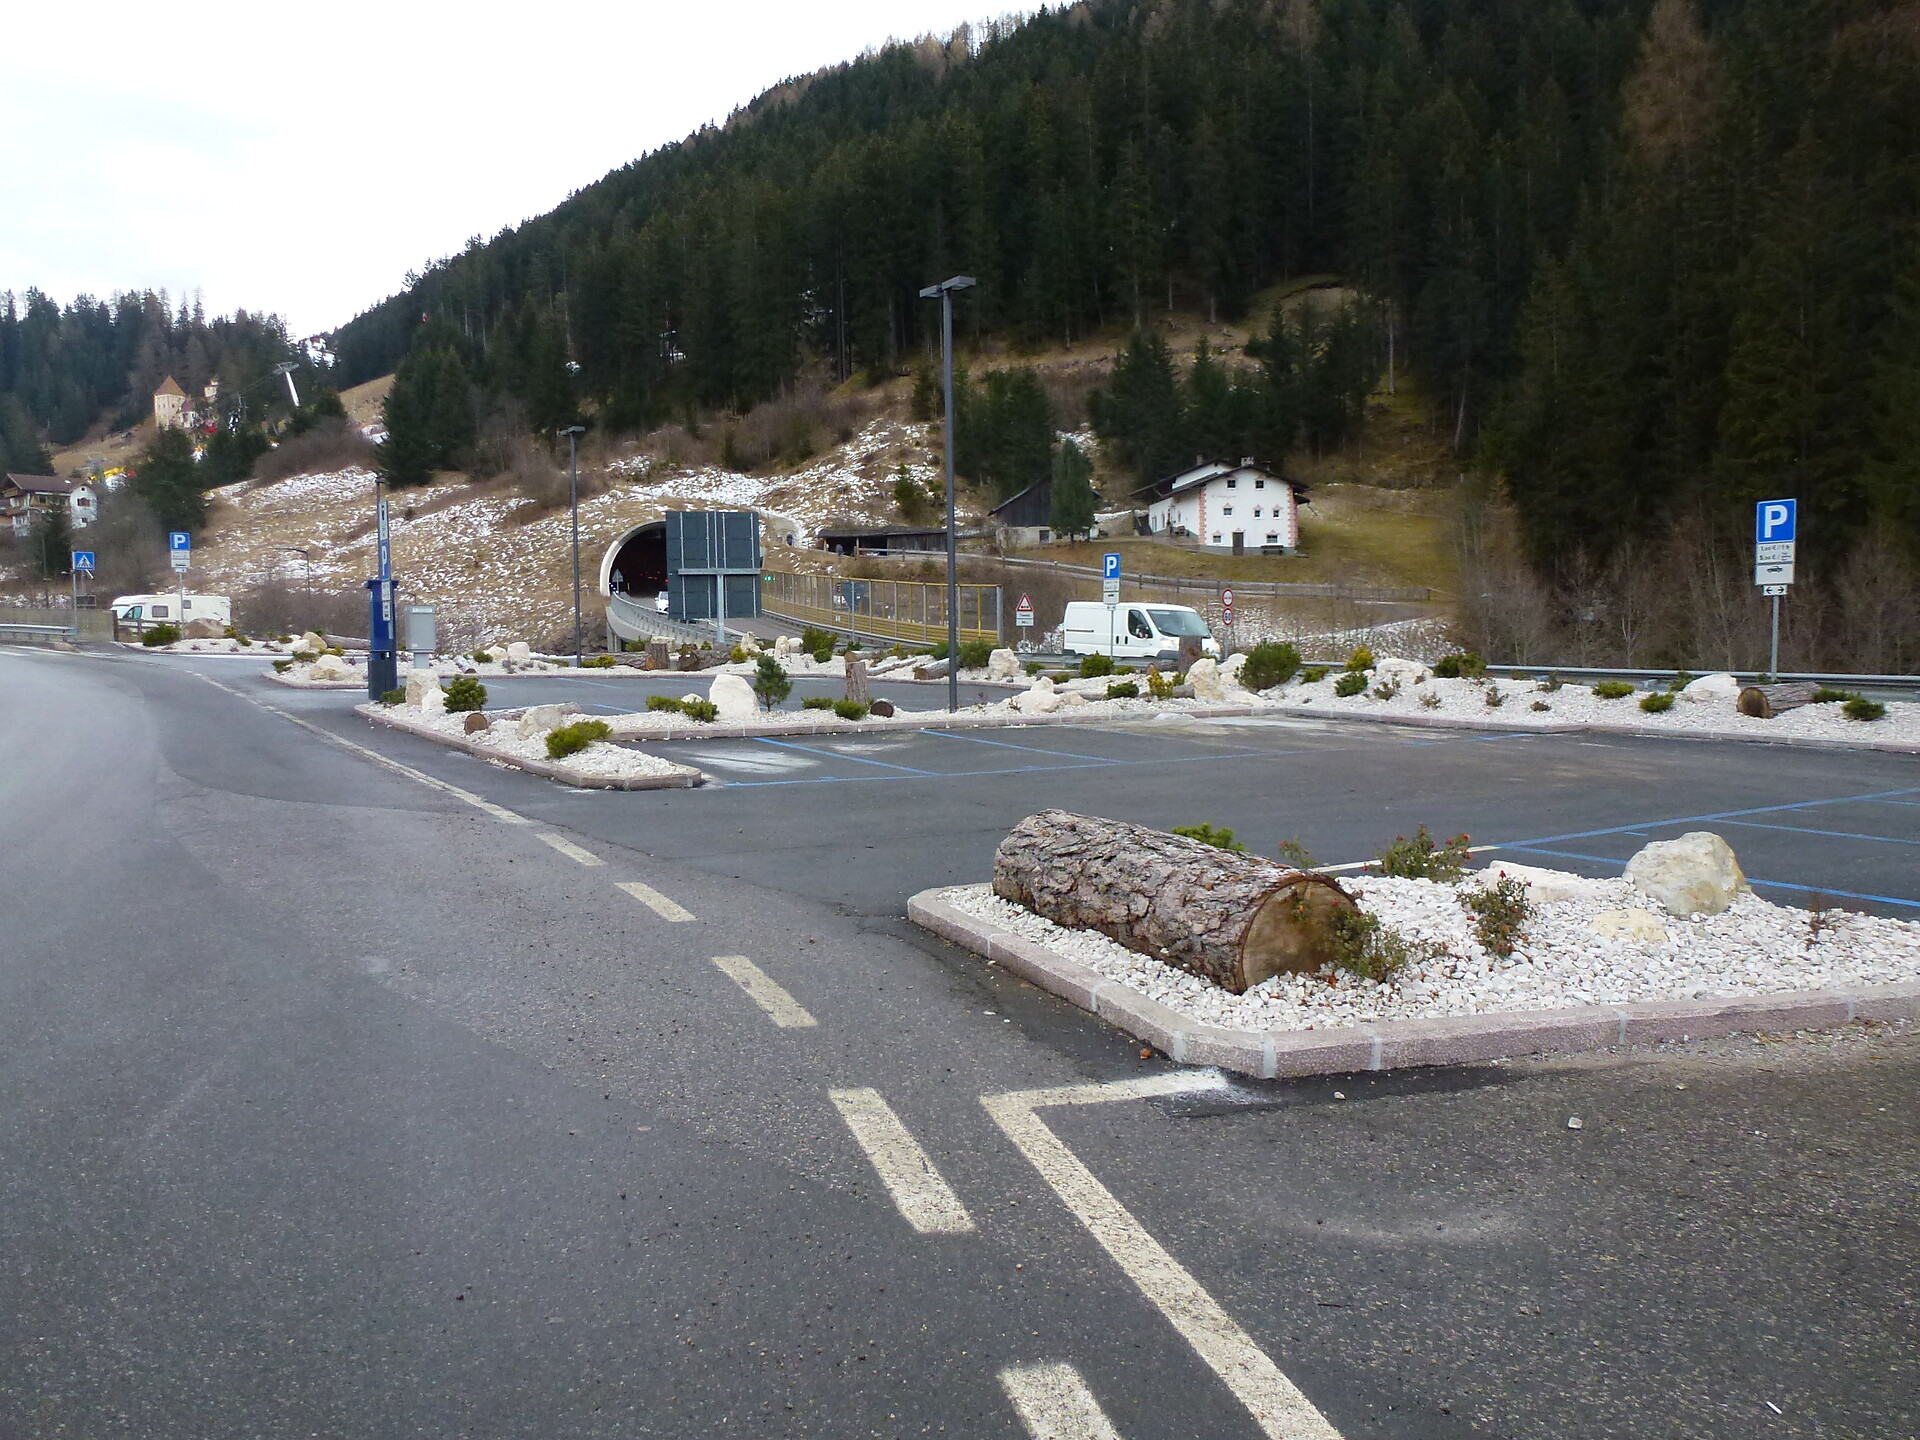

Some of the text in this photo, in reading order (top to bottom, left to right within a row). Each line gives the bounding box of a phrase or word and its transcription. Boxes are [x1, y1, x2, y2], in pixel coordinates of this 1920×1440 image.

[1764, 505, 1788, 538] P
[174, 534, 186, 549] P
[381, 545, 388, 577] P
[1106, 556, 1117, 577] P
